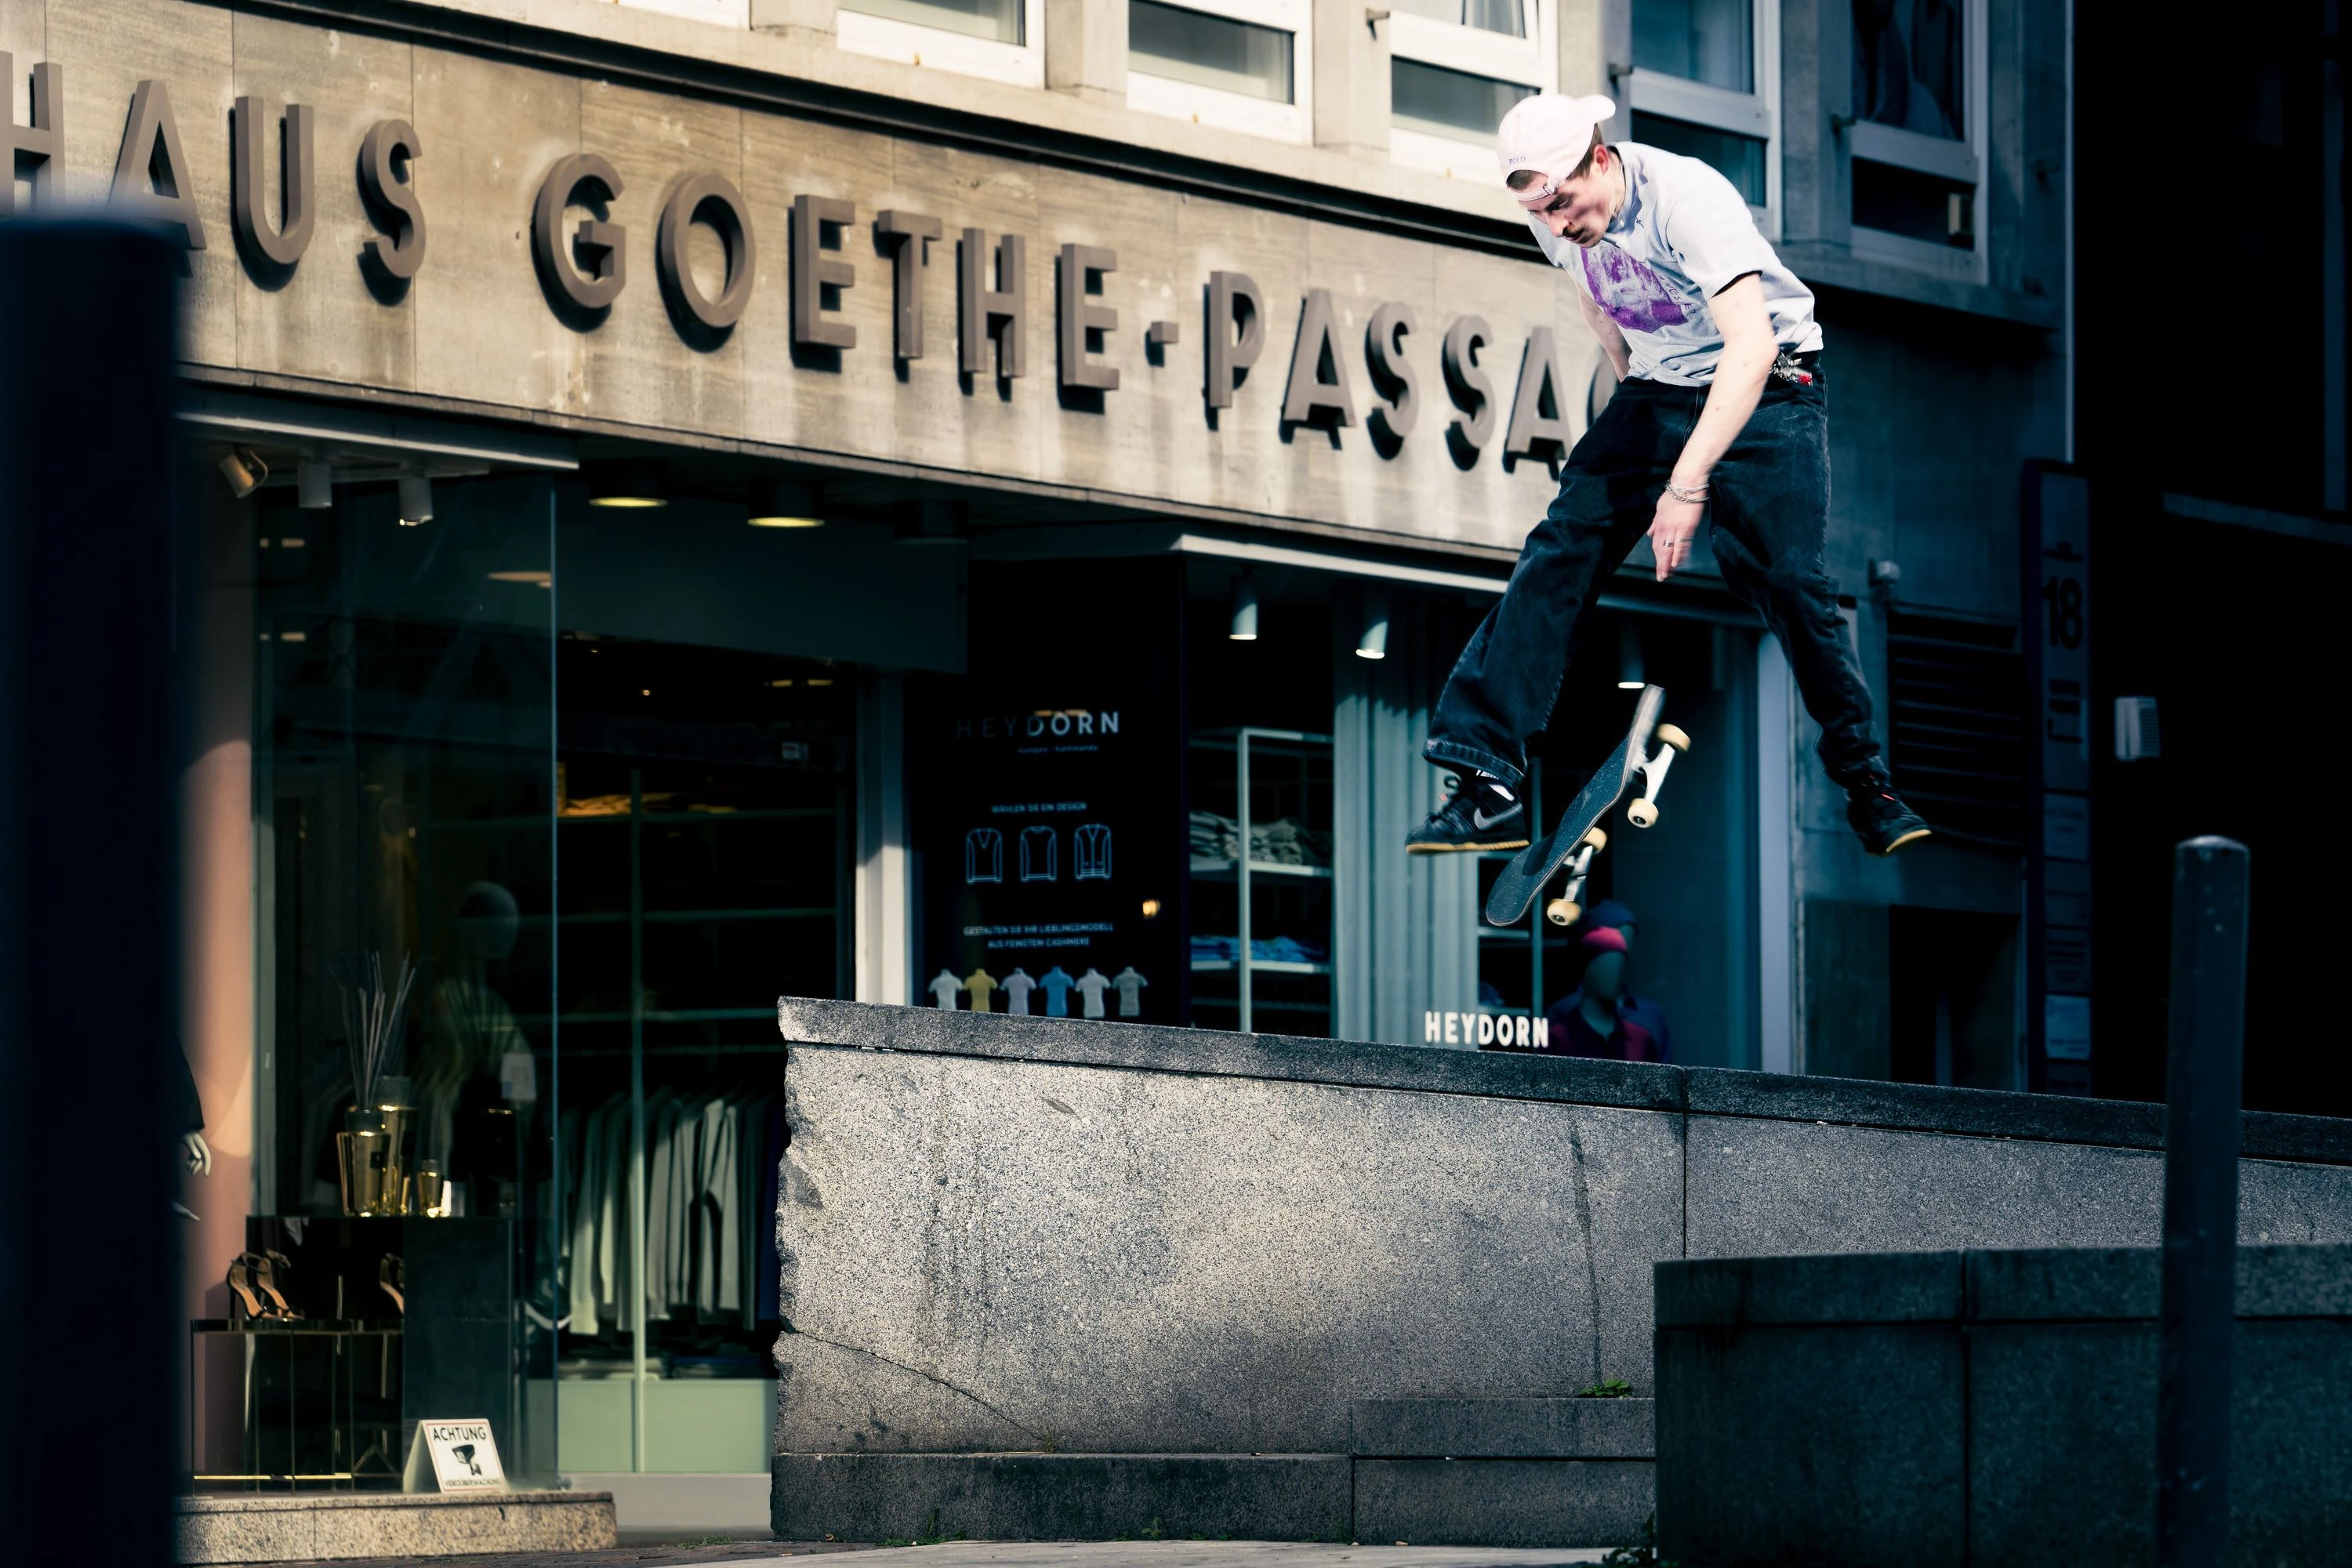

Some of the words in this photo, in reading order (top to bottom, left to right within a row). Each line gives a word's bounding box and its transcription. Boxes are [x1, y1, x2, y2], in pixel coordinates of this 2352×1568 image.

[0, 51, 426, 278] HAUS
[2041, 575, 2083, 650] 18
[956, 710, 1120, 739] HEYDORN
[1028, 803, 1039, 812] SIE
[1055, 801, 1087, 811] DESIGN
[1425, 1011, 1548, 1048] HEYDORN
[434, 1426, 487, 1441] ACHTUNG
